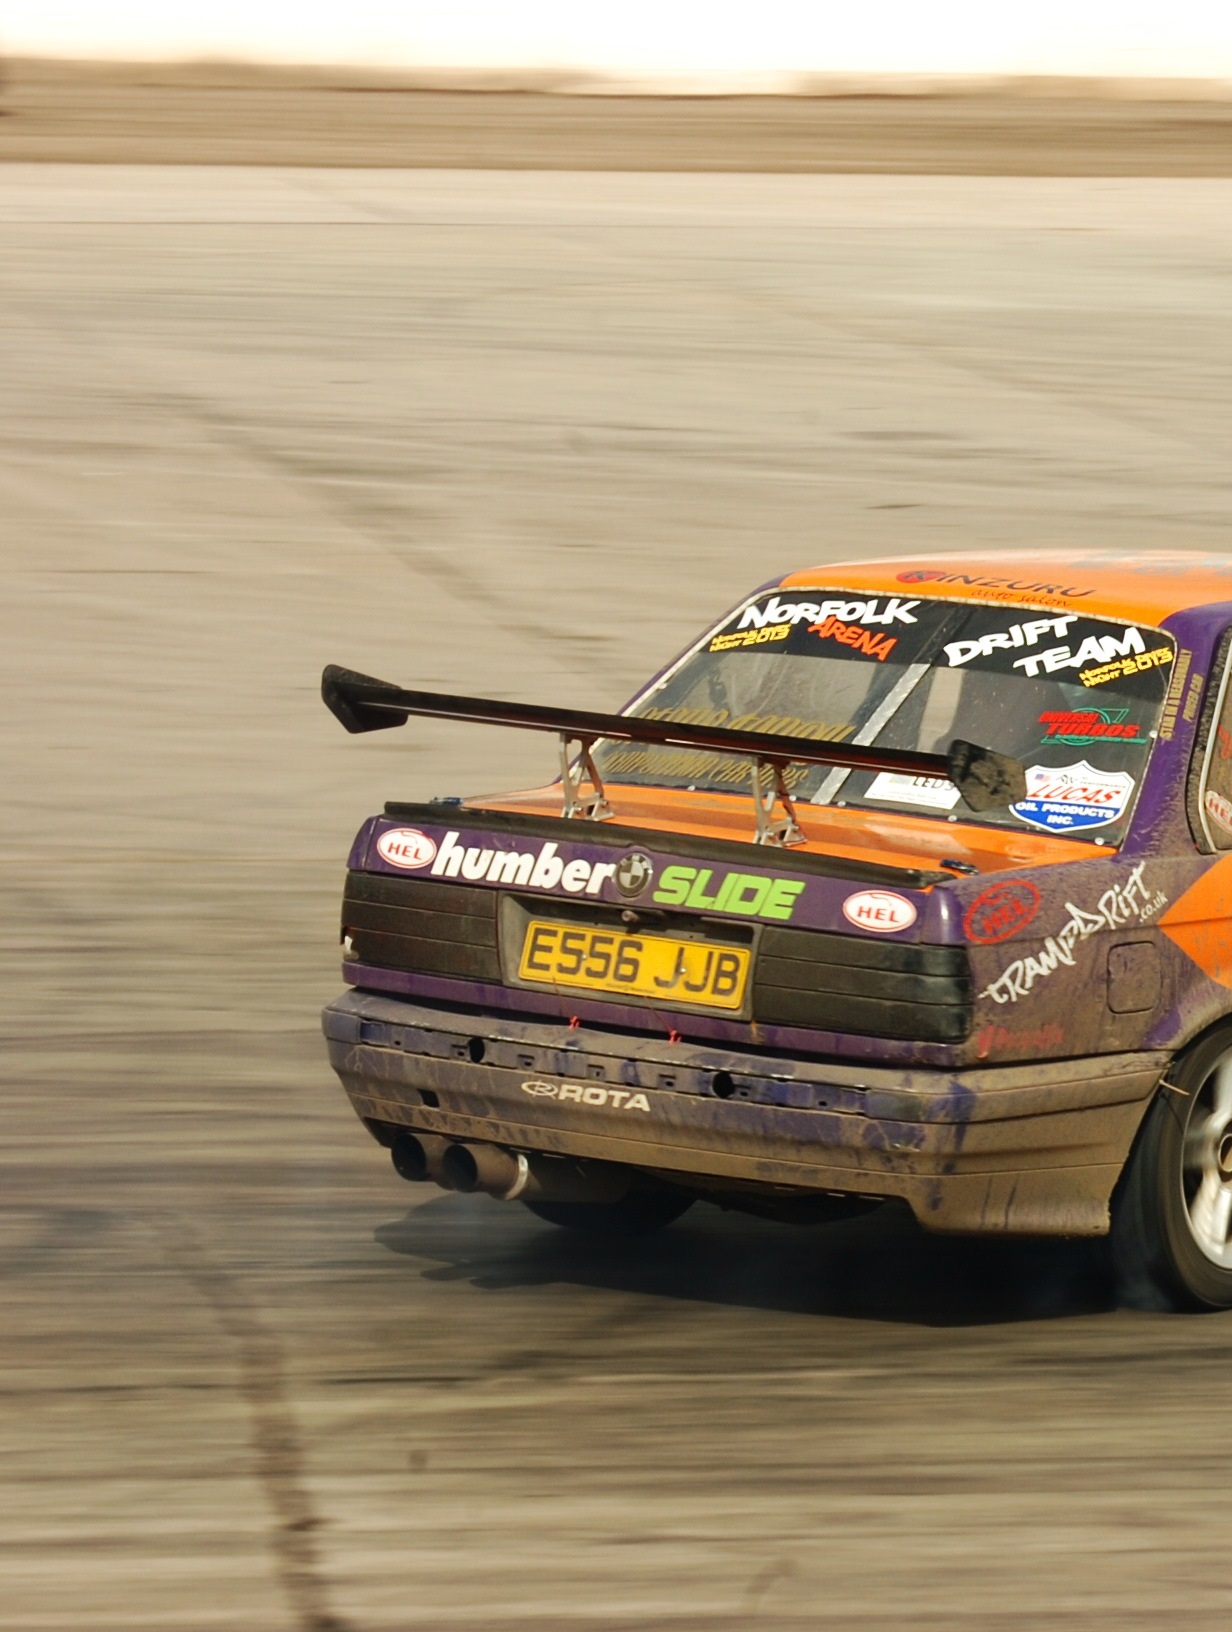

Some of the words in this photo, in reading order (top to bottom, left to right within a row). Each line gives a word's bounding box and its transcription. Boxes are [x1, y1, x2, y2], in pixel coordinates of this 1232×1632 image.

[737, 596, 921, 629] NORFOLK
[807, 614, 898, 662] ARENA
[944, 615, 1078, 667] DRIFT
[1013, 626, 1146, 677] TEAM
[1045, 722, 1141, 738] TURBOS
[1015, 801, 1039, 811] OIL
[1041, 802, 1116, 819] PRODUCTS
[1026, 784, 1121, 804] LUCAS
[387, 841, 422, 860] HEL
[431, 831, 617, 894] humber
[652, 864, 806, 920] SLIDE
[857, 905, 900, 924] HEL
[981, 898, 1029, 935] HEL
[527, 926, 644, 983] E556
[653, 946, 741, 997] JJB
[558, 1084, 650, 1112] ROTA
